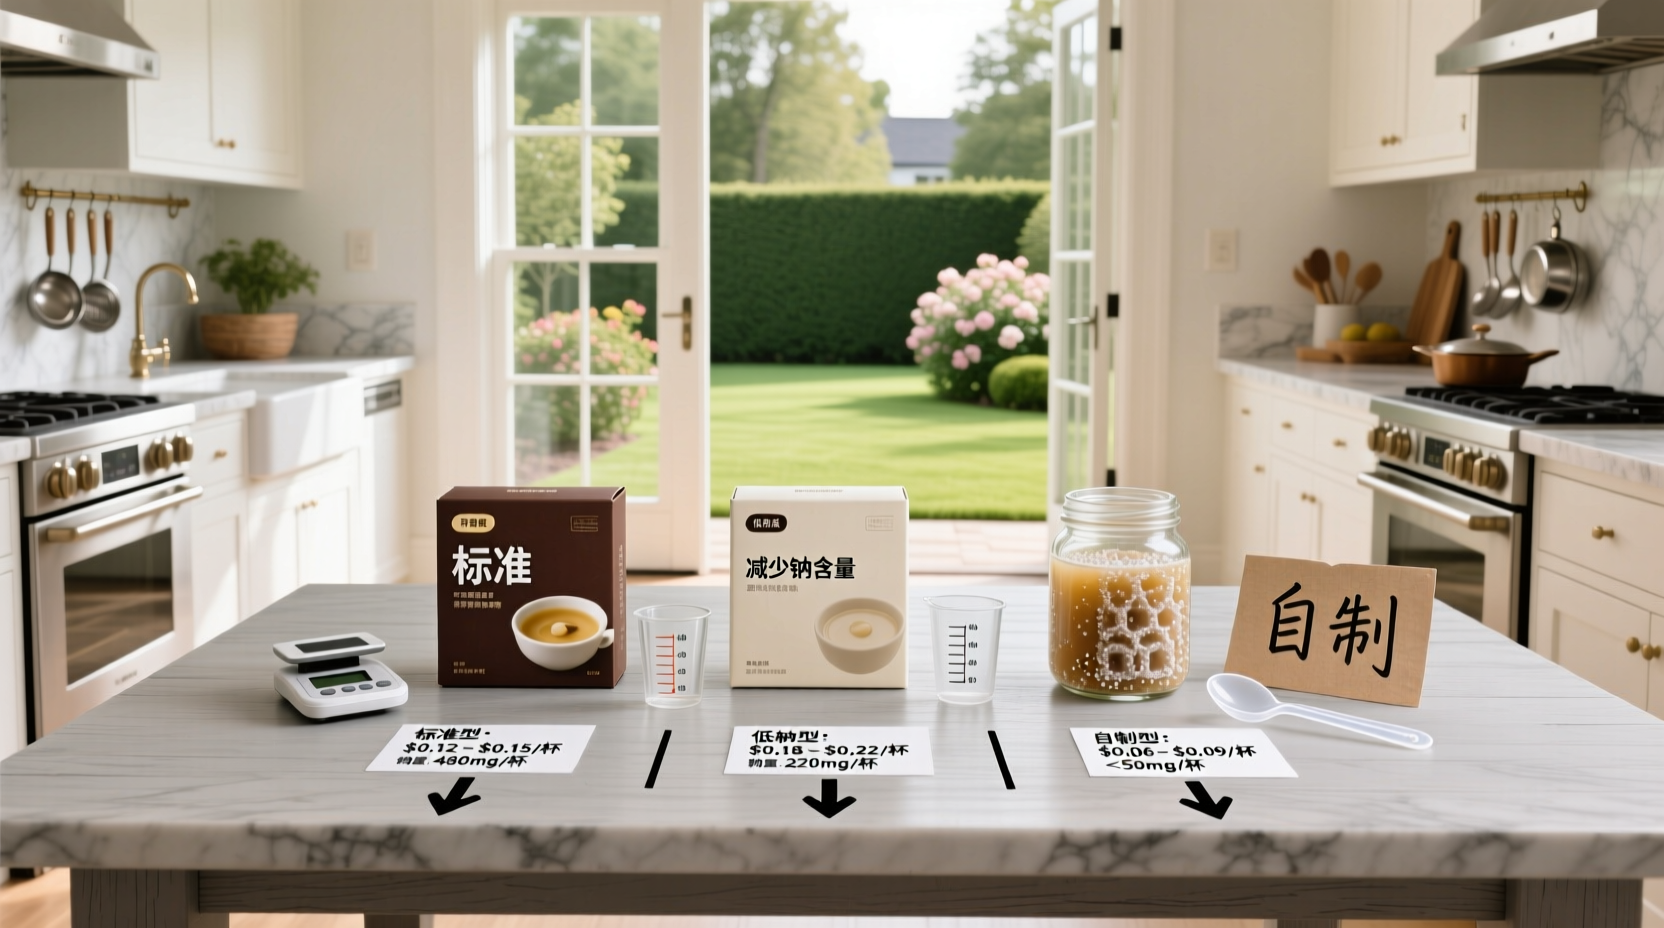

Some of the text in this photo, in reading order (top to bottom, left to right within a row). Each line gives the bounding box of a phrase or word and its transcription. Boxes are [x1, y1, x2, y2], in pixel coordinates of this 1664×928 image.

[452, 545, 532, 586] 标准
[745, 556, 856, 580] 减少钠含量
[1269, 582, 1397, 678] 自制
